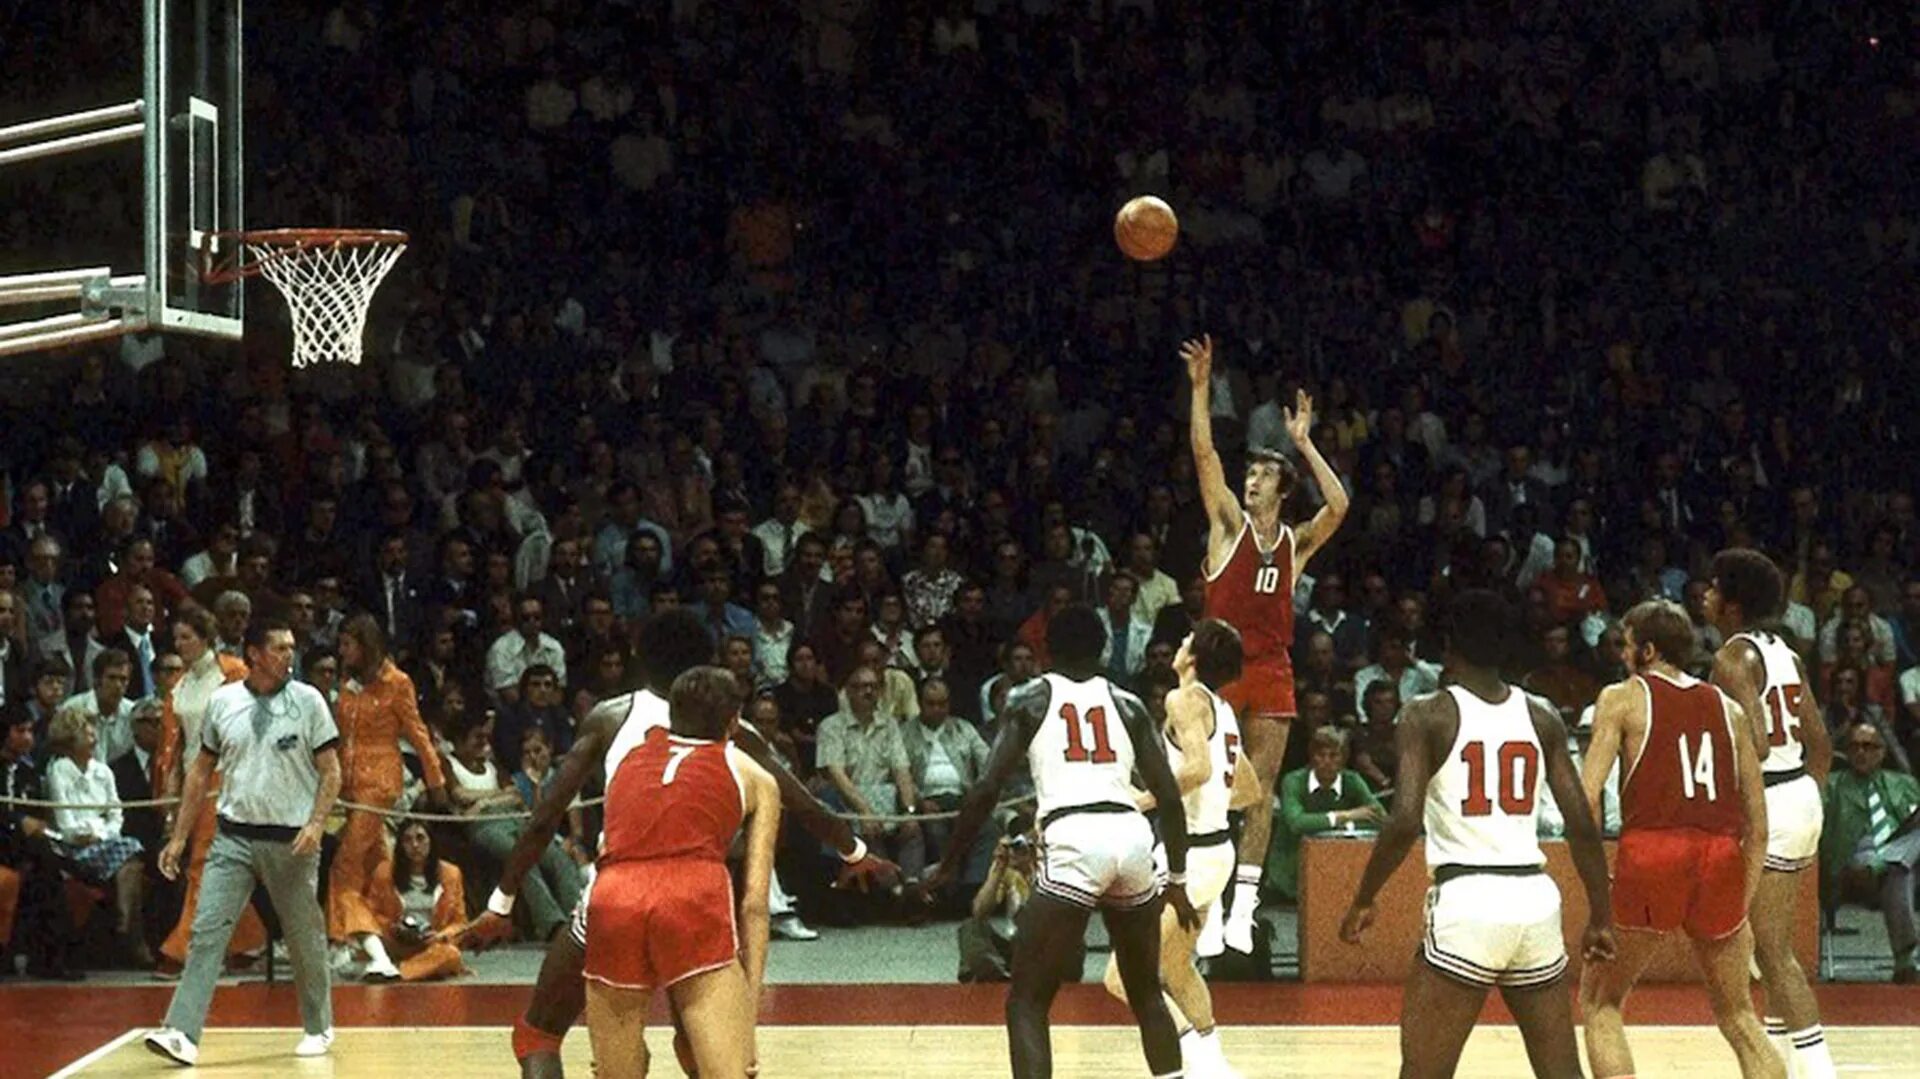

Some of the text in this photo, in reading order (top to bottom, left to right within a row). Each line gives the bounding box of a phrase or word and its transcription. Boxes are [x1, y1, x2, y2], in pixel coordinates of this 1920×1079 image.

[1255, 567, 1279, 593] 10
[1059, 702, 1117, 764] 11
[662, 745, 696, 785] 7
[1460, 741, 1539, 816] 10
[1679, 731, 1716, 802] 14
